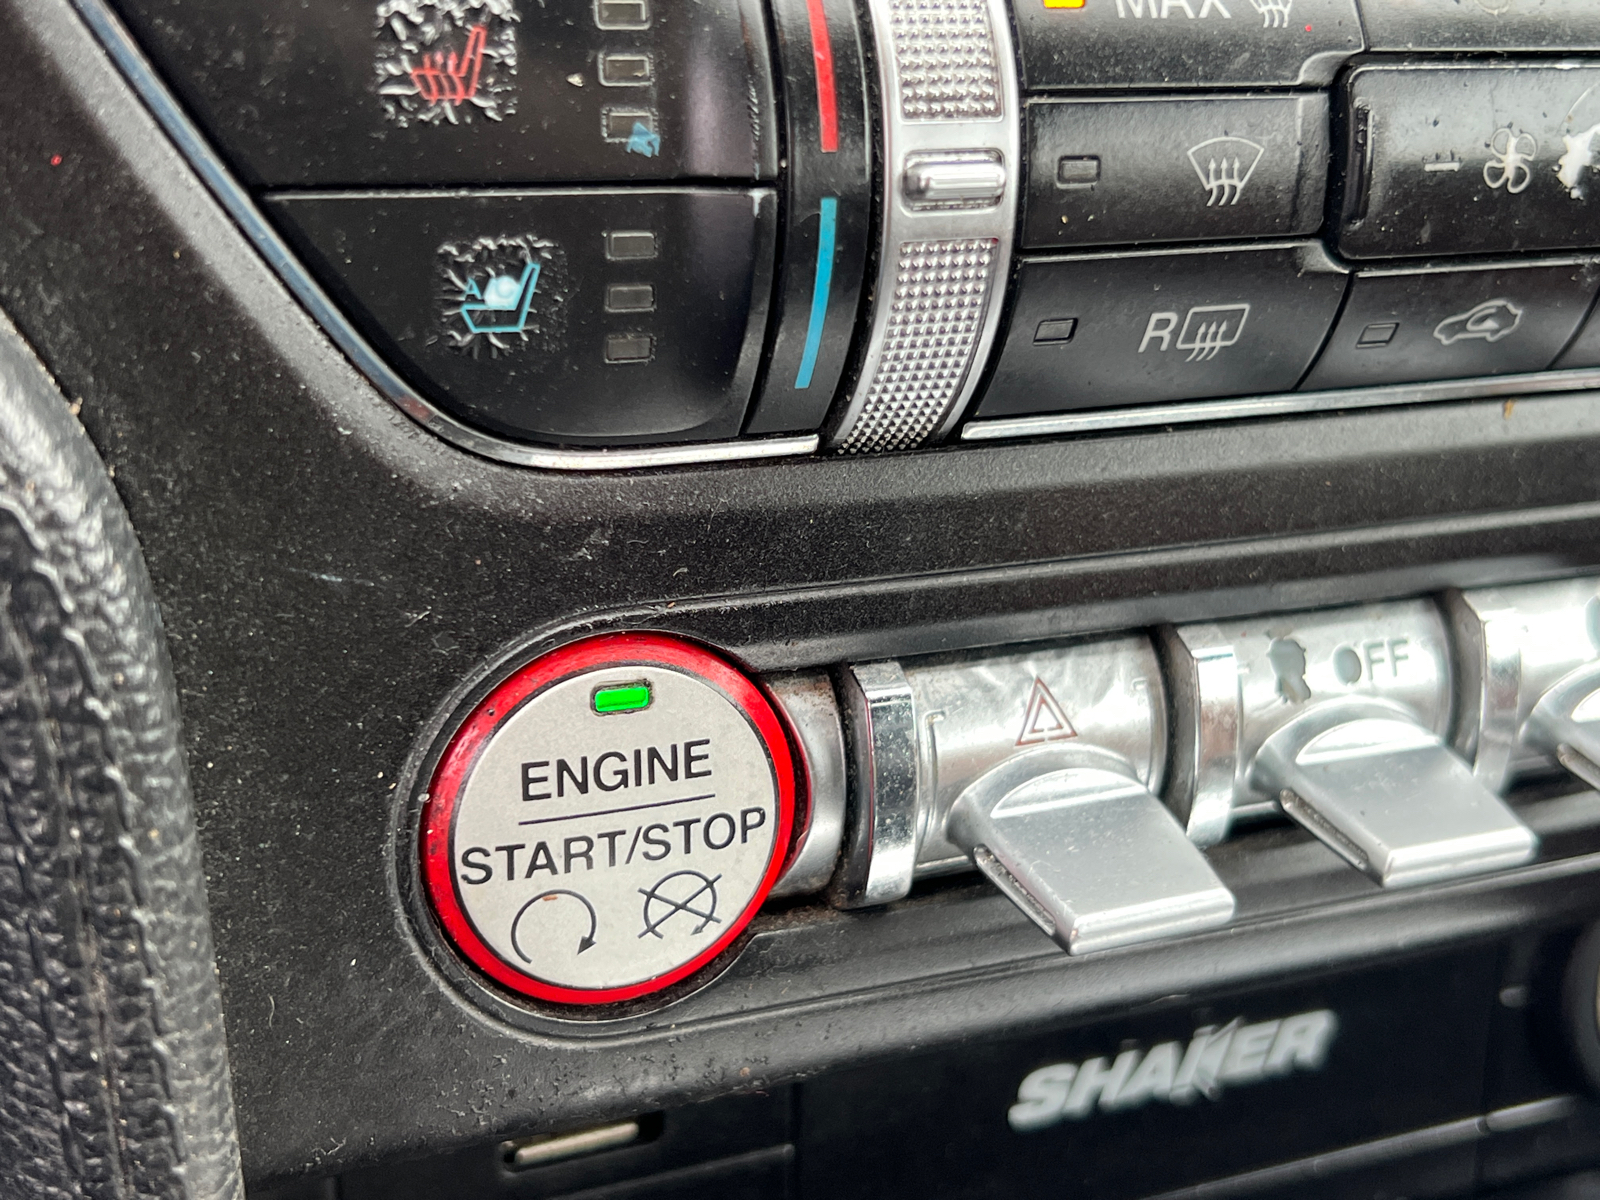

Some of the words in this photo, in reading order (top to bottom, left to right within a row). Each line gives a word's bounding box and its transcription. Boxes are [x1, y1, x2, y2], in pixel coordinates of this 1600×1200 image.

[1138, 312, 1178, 353] R
[1333, 637, 1409, 686] OFF
[520, 738, 712, 802] ENGINE
[460, 806, 767, 886] START/STOP
[1008, 1009, 1337, 1130] SHAKER
